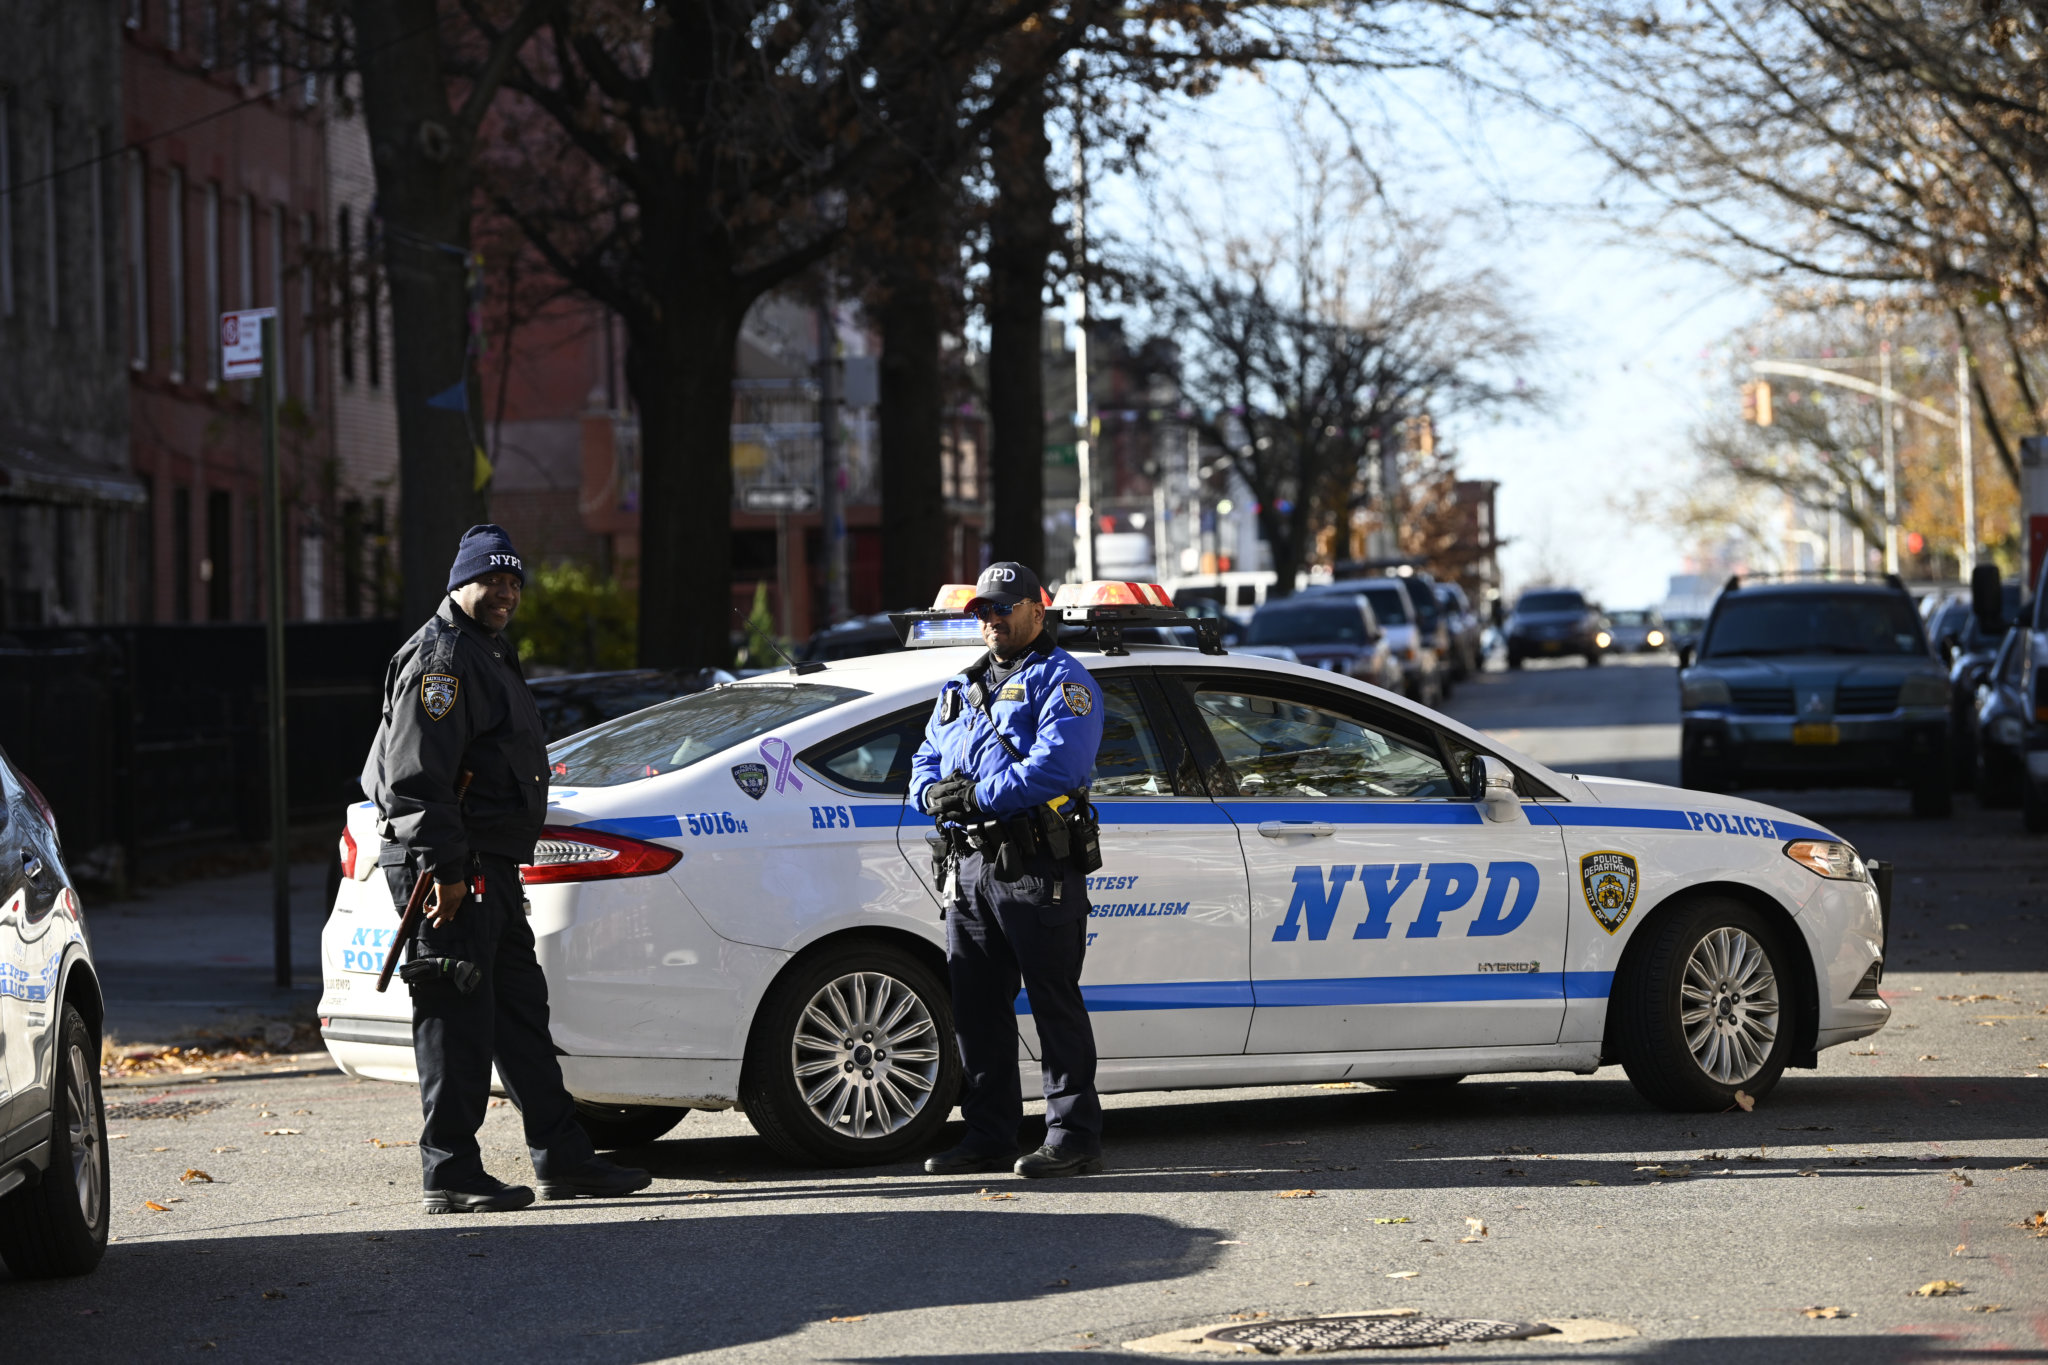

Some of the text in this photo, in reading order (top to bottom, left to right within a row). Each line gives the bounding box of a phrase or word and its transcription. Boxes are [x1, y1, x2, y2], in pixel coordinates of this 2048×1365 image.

[809, 805, 850, 829] APS
[1686, 811, 1776, 839] POLICE
[1593, 854, 1624, 865] POLICE
[1584, 863, 1635, 879] DEPARTMENT
[1086, 876, 1138, 890] RTESY
[1089, 902, 1190, 918] SSIONALISM
[1271, 861, 1540, 942] NYPD
[1585, 887, 1597, 907] CITY
[1616, 906, 1629, 923] NEW
[1626, 882, 1636, 903] YORK
[352, 928, 398, 948] NY
[1478, 962, 1529, 972] HYBRID
